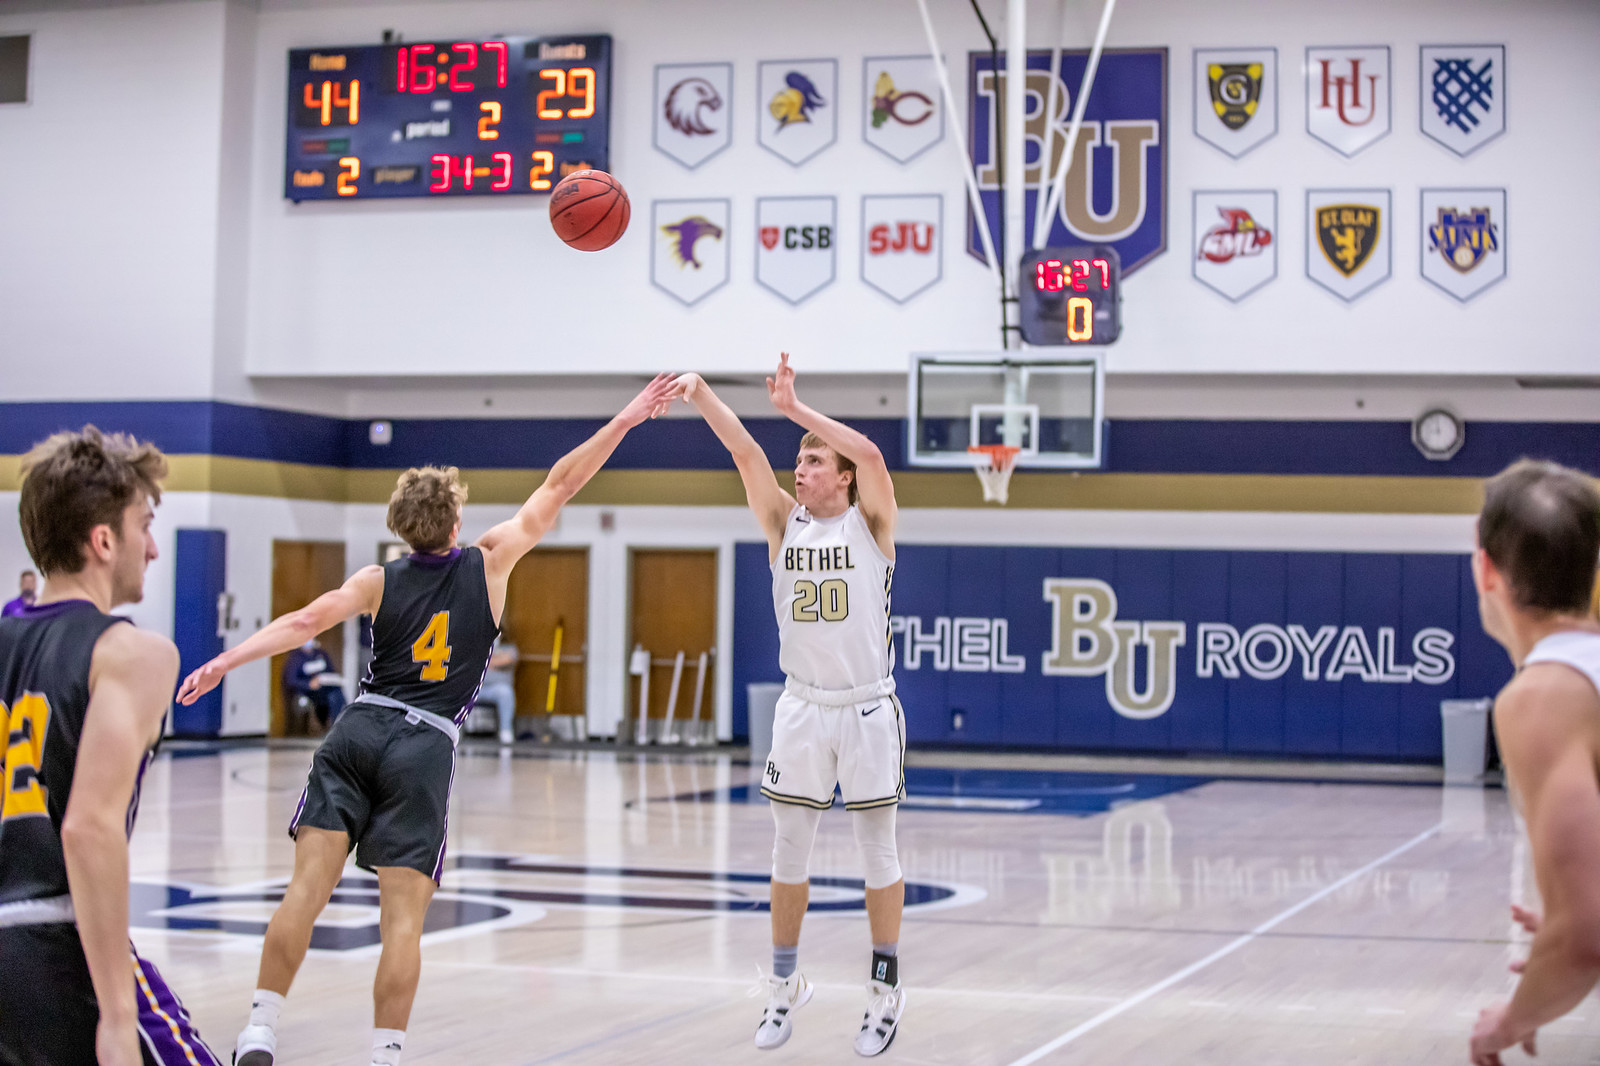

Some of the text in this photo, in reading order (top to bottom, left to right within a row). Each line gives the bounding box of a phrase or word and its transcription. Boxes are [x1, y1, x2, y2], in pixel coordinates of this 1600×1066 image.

[397, 41, 507, 93] 16:27
[304, 79, 360, 125] 44
[536, 67, 595, 120] 29
[477, 101, 501, 140] 2
[337, 157, 360, 196] 2
[530, 150, 553, 190] 2
[977, 69, 1159, 242] BU
[784, 226, 832, 249] CSB
[869, 221, 934, 255] SJU
[1036, 259, 1109, 291] 16:27
[1067, 297, 1093, 341] 0
[784, 545, 855, 572] BETHEL
[792, 578, 849, 622] 20
[411, 609, 452, 682] 4
[1043, 578, 1187, 720] BU
[1194, 623, 1456, 685] ROYALS
[0, 690, 52, 824] 2
[766, 760, 781, 785] BU
